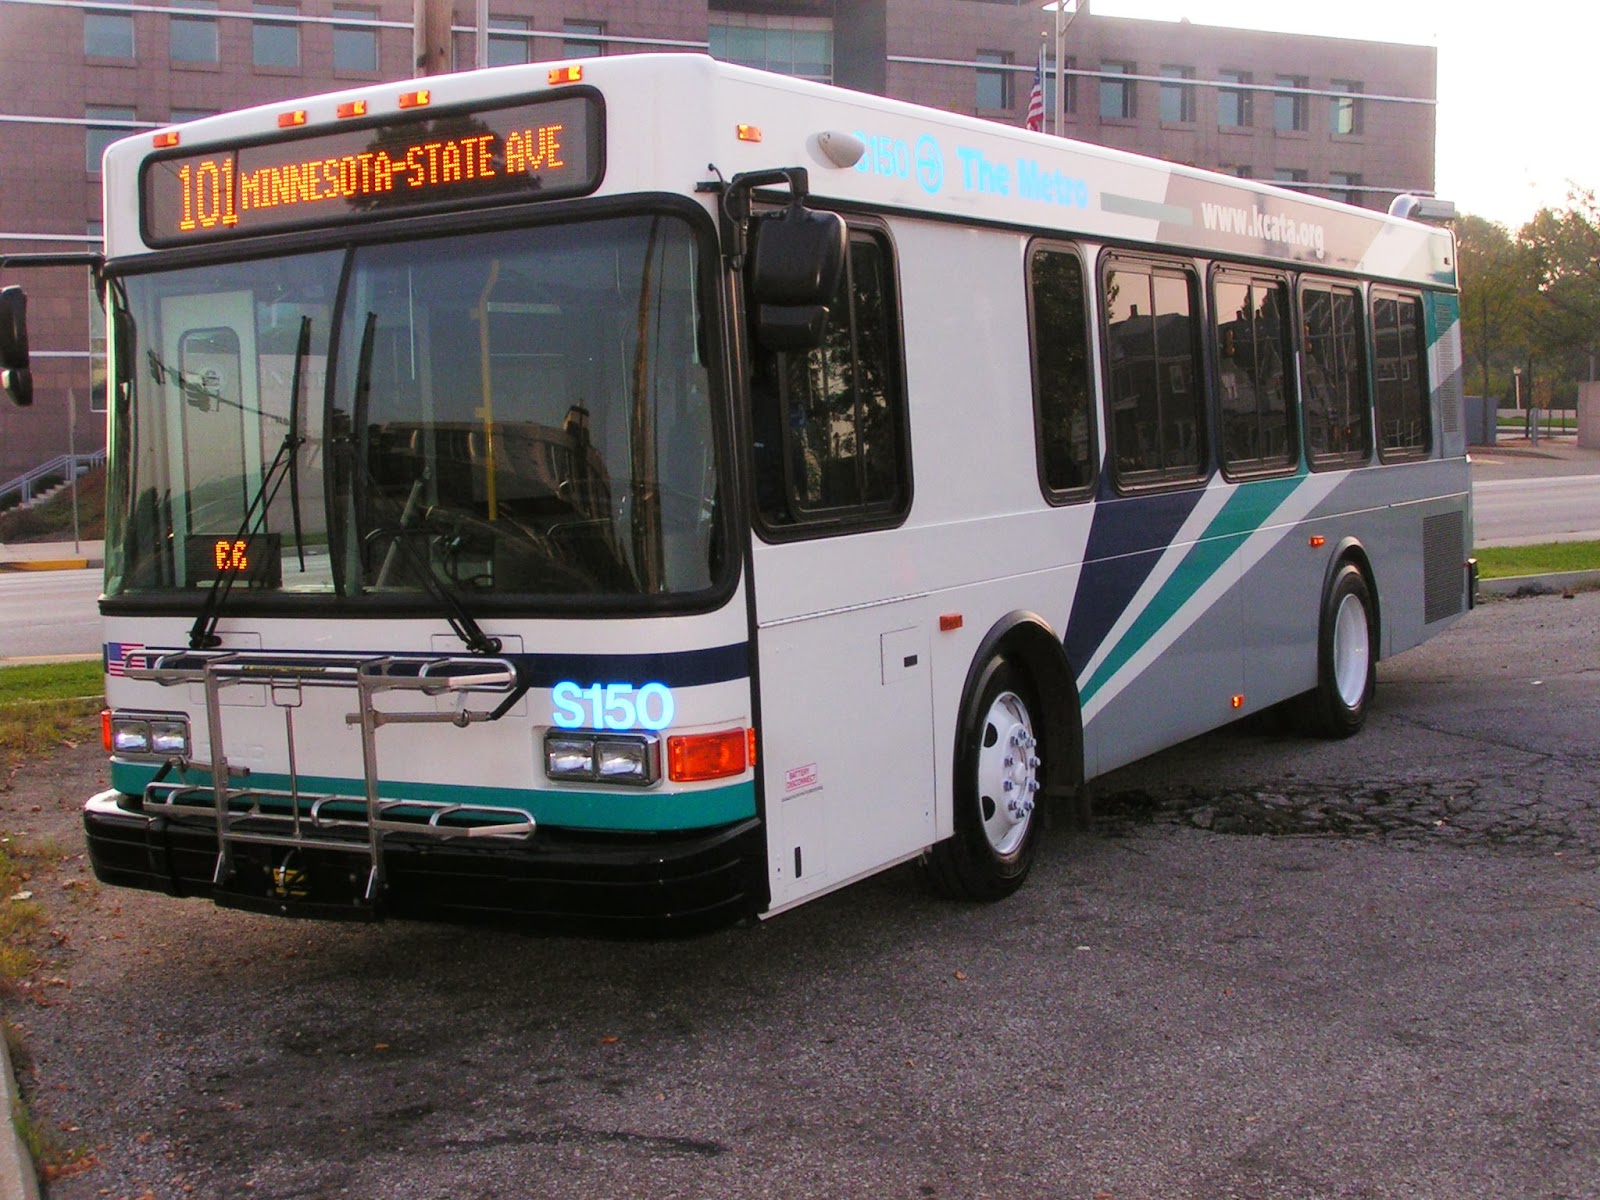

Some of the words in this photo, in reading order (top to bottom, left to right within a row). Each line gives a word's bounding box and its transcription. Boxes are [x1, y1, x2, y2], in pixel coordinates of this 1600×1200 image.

[179, 157, 238, 231] 101
[240, 134, 496, 210] MINNESOTA-STATE
[505, 124, 564, 174] AVE
[956, 144, 1009, 197] The
[1016, 157, 1089, 209] Metro
[1200, 201, 1324, 259] www.kcata.org
[552, 681, 674, 730] S150
